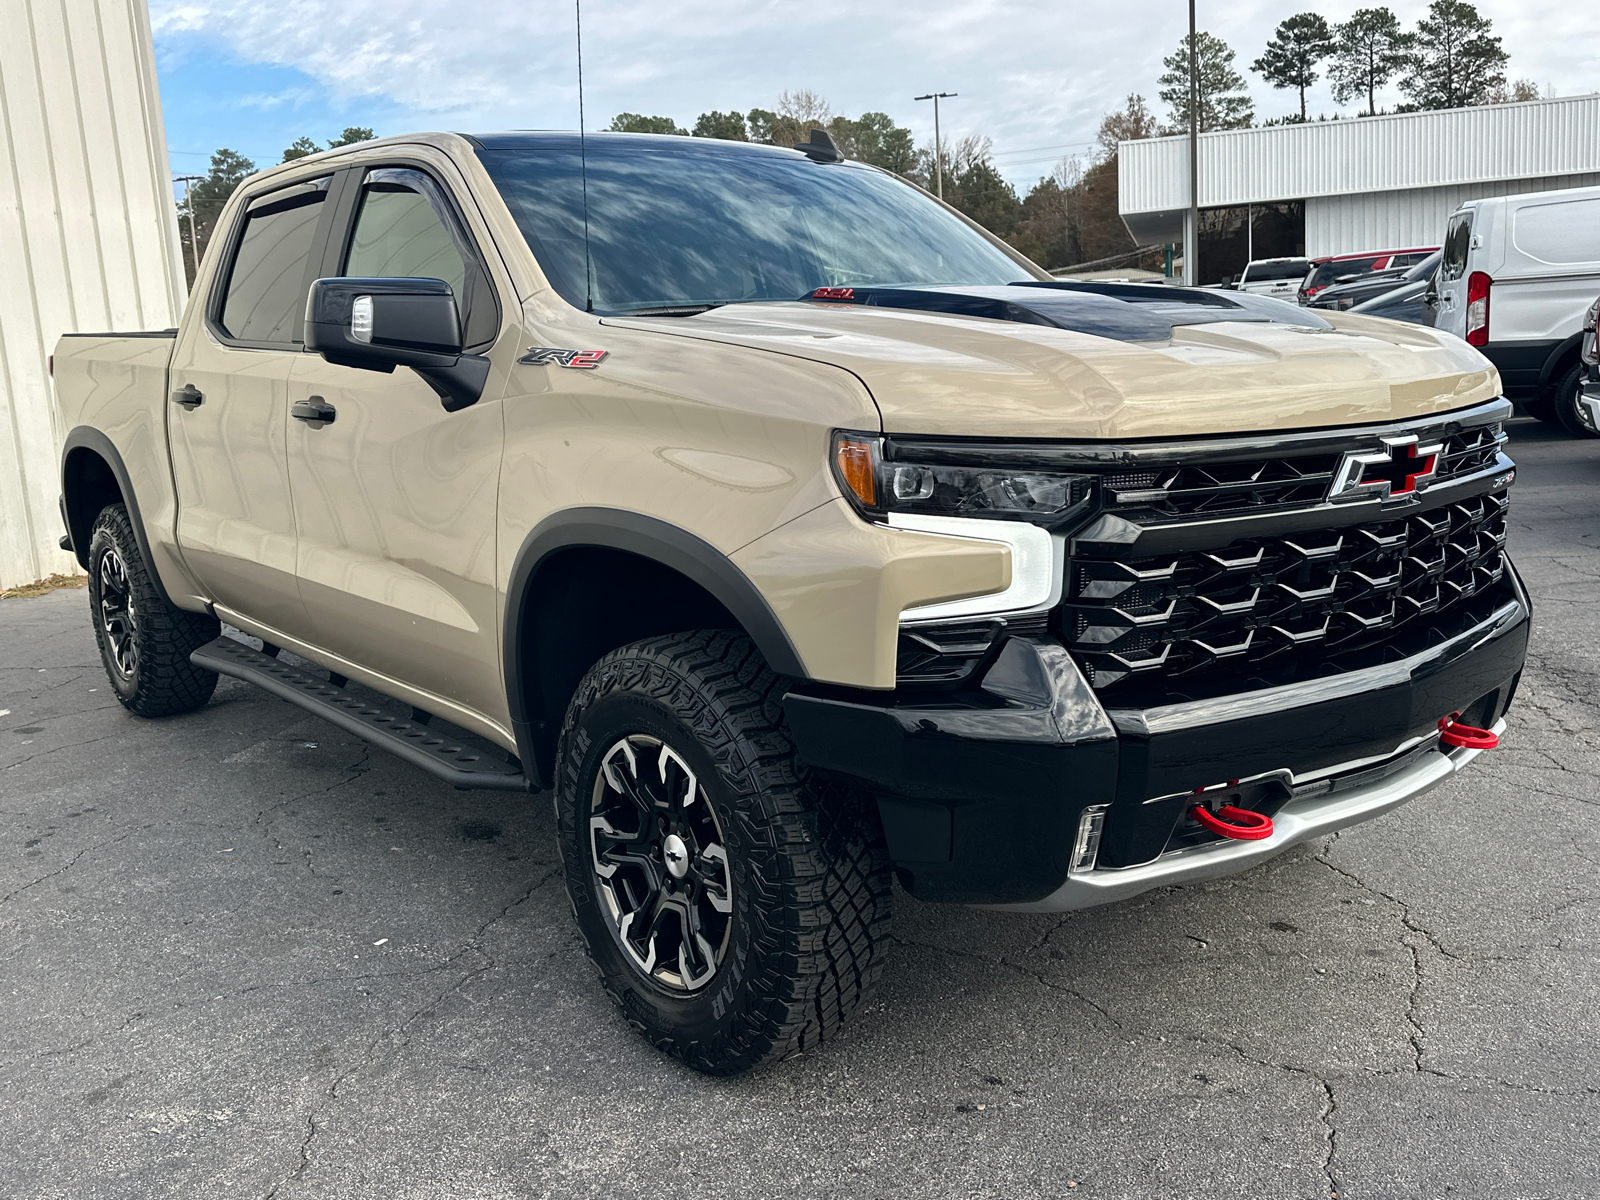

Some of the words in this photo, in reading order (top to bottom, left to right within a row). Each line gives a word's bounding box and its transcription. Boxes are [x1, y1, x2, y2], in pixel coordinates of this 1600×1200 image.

[516, 346, 611, 370] ZR2
[562, 727, 593, 907] WRANGLER
[711, 803, 752, 1022] GOODYEAR
